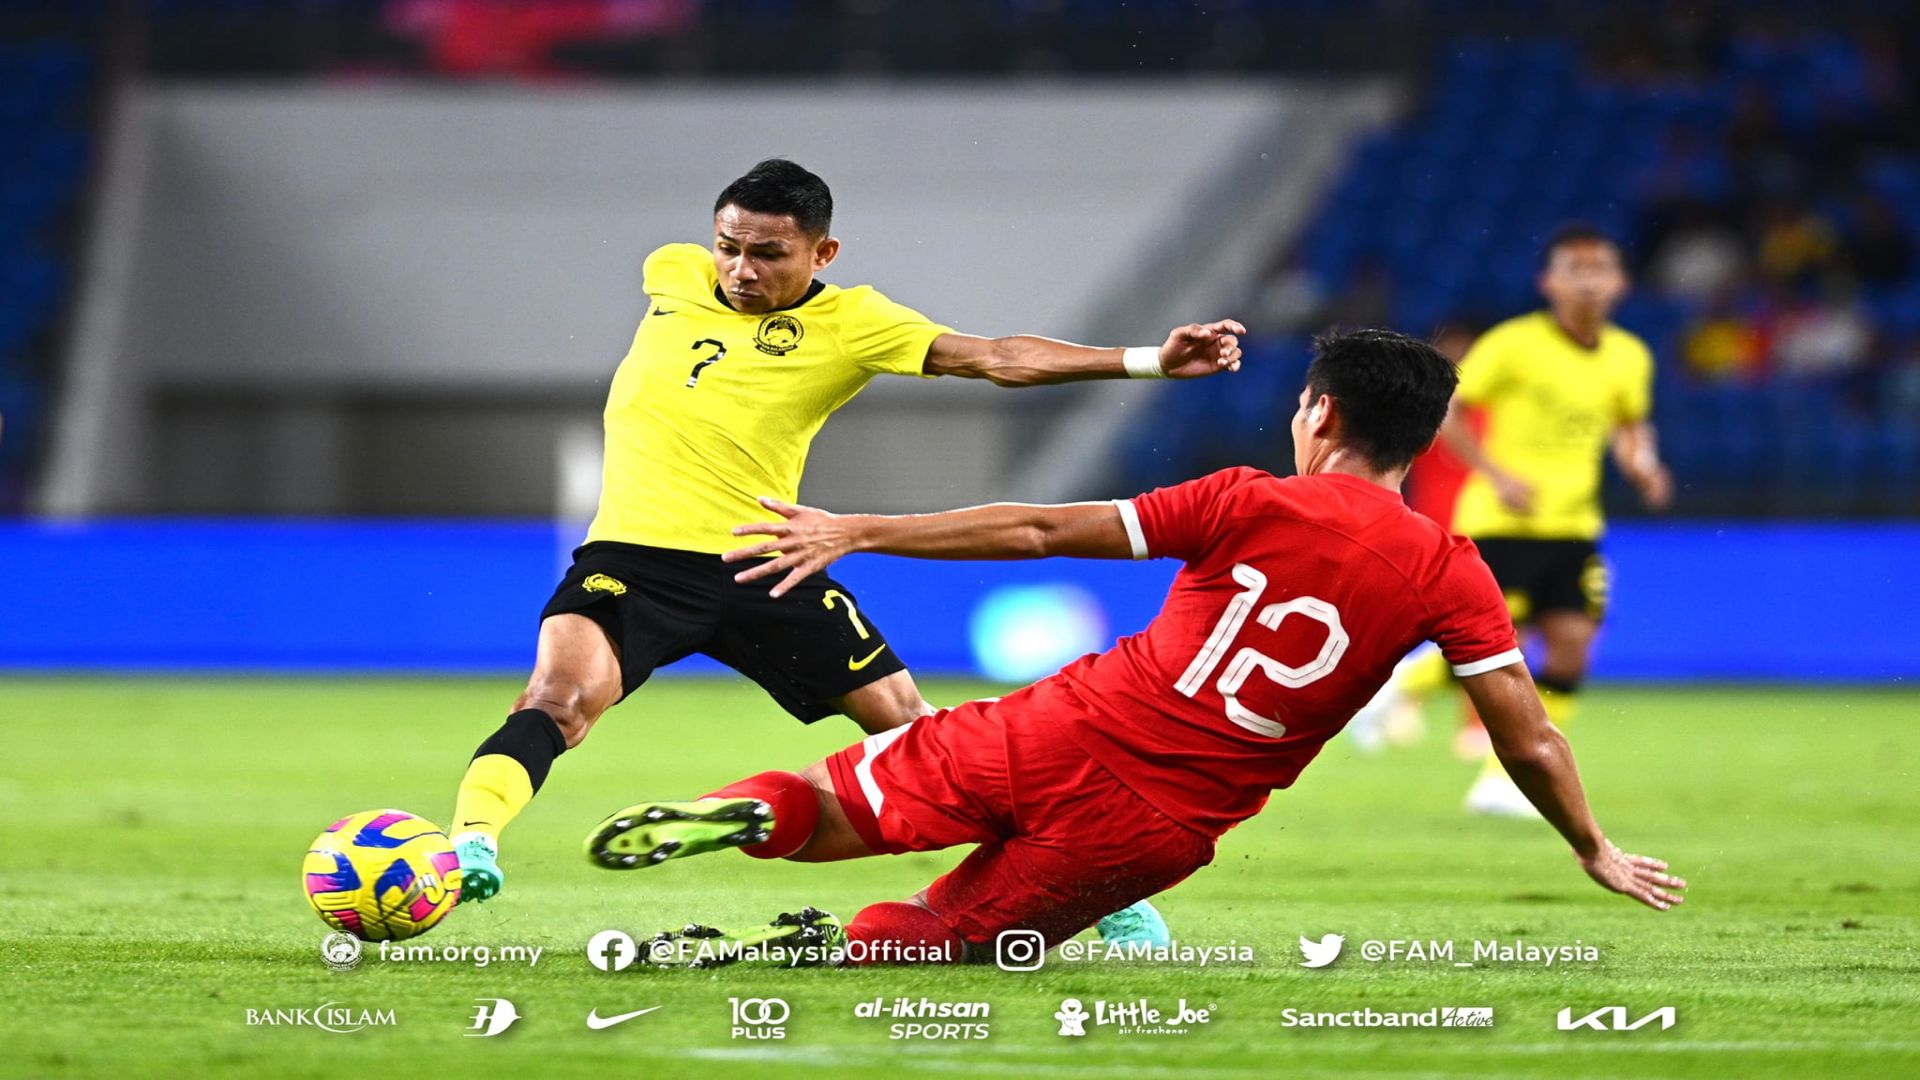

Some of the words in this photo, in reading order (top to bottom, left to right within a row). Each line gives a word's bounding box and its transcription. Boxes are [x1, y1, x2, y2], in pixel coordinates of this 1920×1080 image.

[686, 338, 727, 388] 7
[822, 589, 870, 640] 7
[1173, 563, 1350, 738] 12
